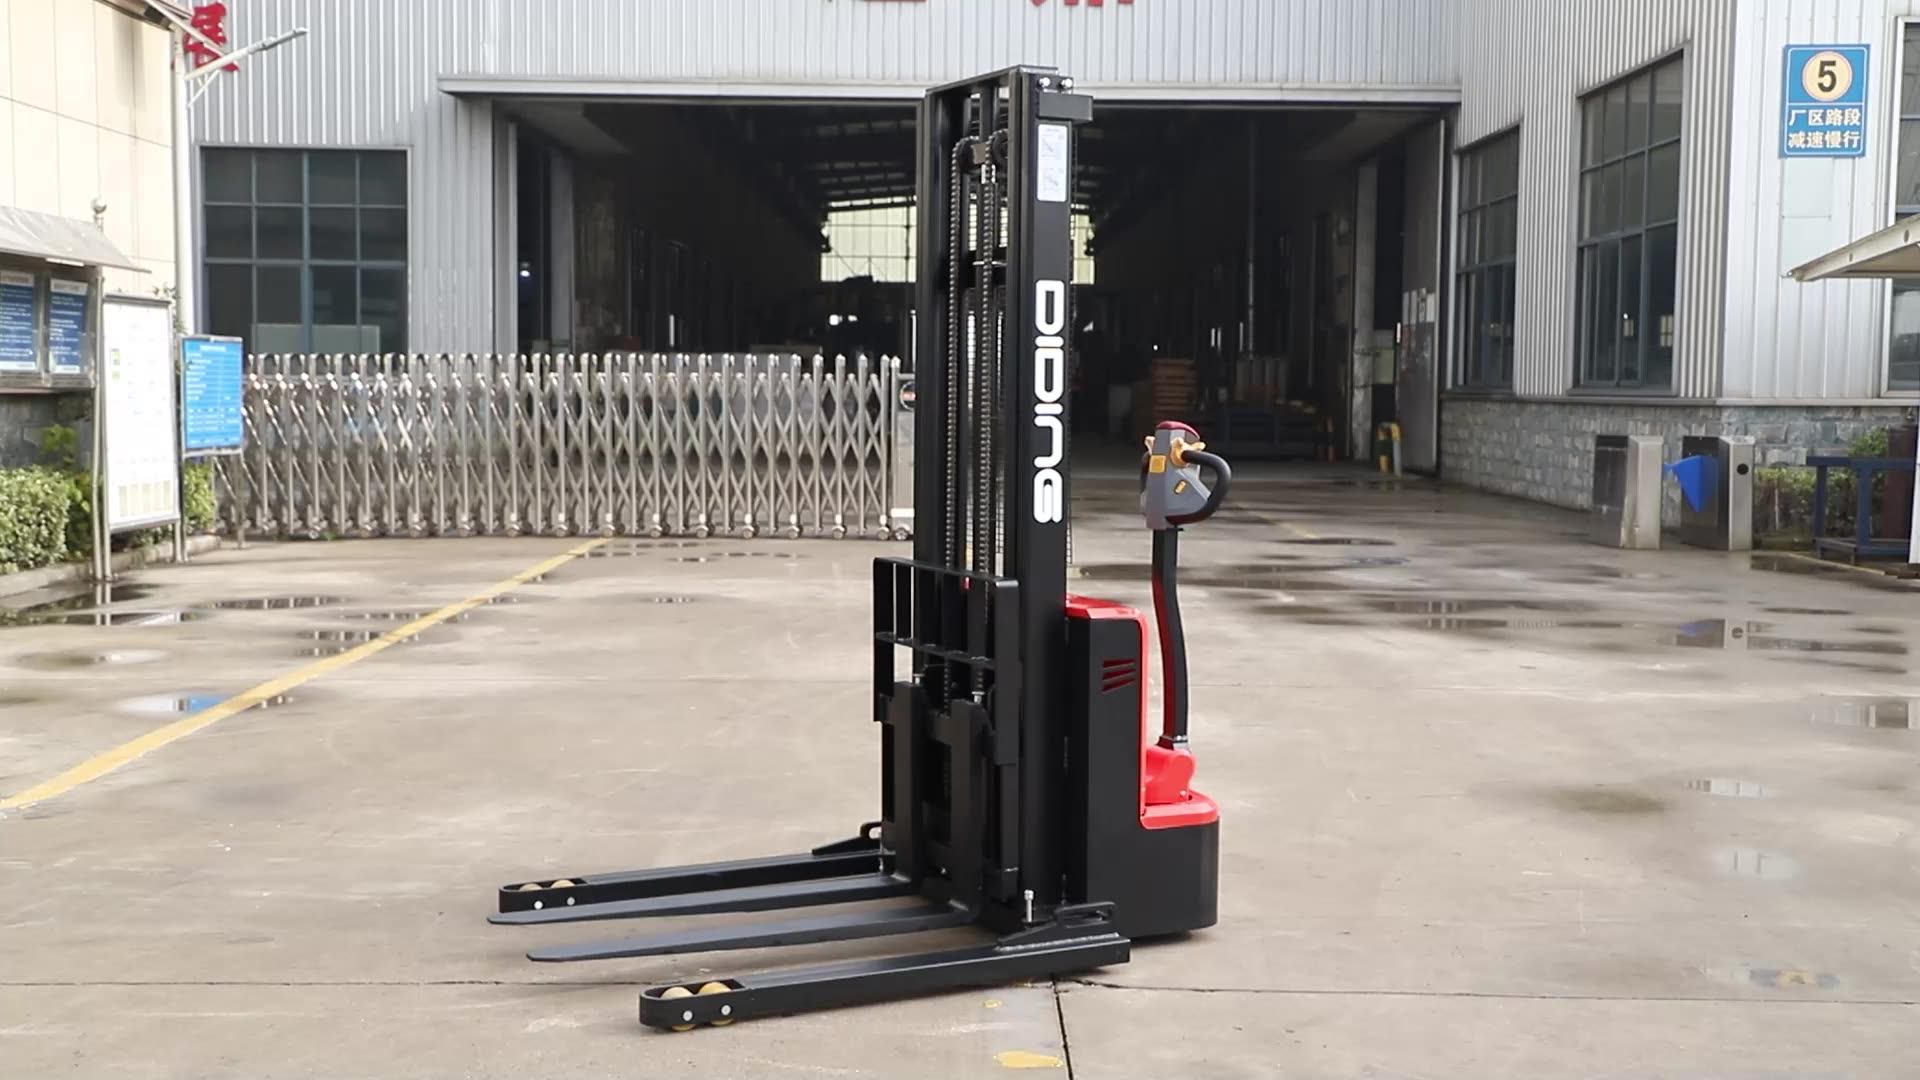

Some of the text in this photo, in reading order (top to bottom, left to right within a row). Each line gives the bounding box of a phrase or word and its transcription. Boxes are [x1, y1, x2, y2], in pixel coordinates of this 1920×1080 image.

[1817, 60, 1837, 93] 5
[1788, 108, 1861, 126] 厂区路段
[1787, 130, 1861, 149] 减速慢行
